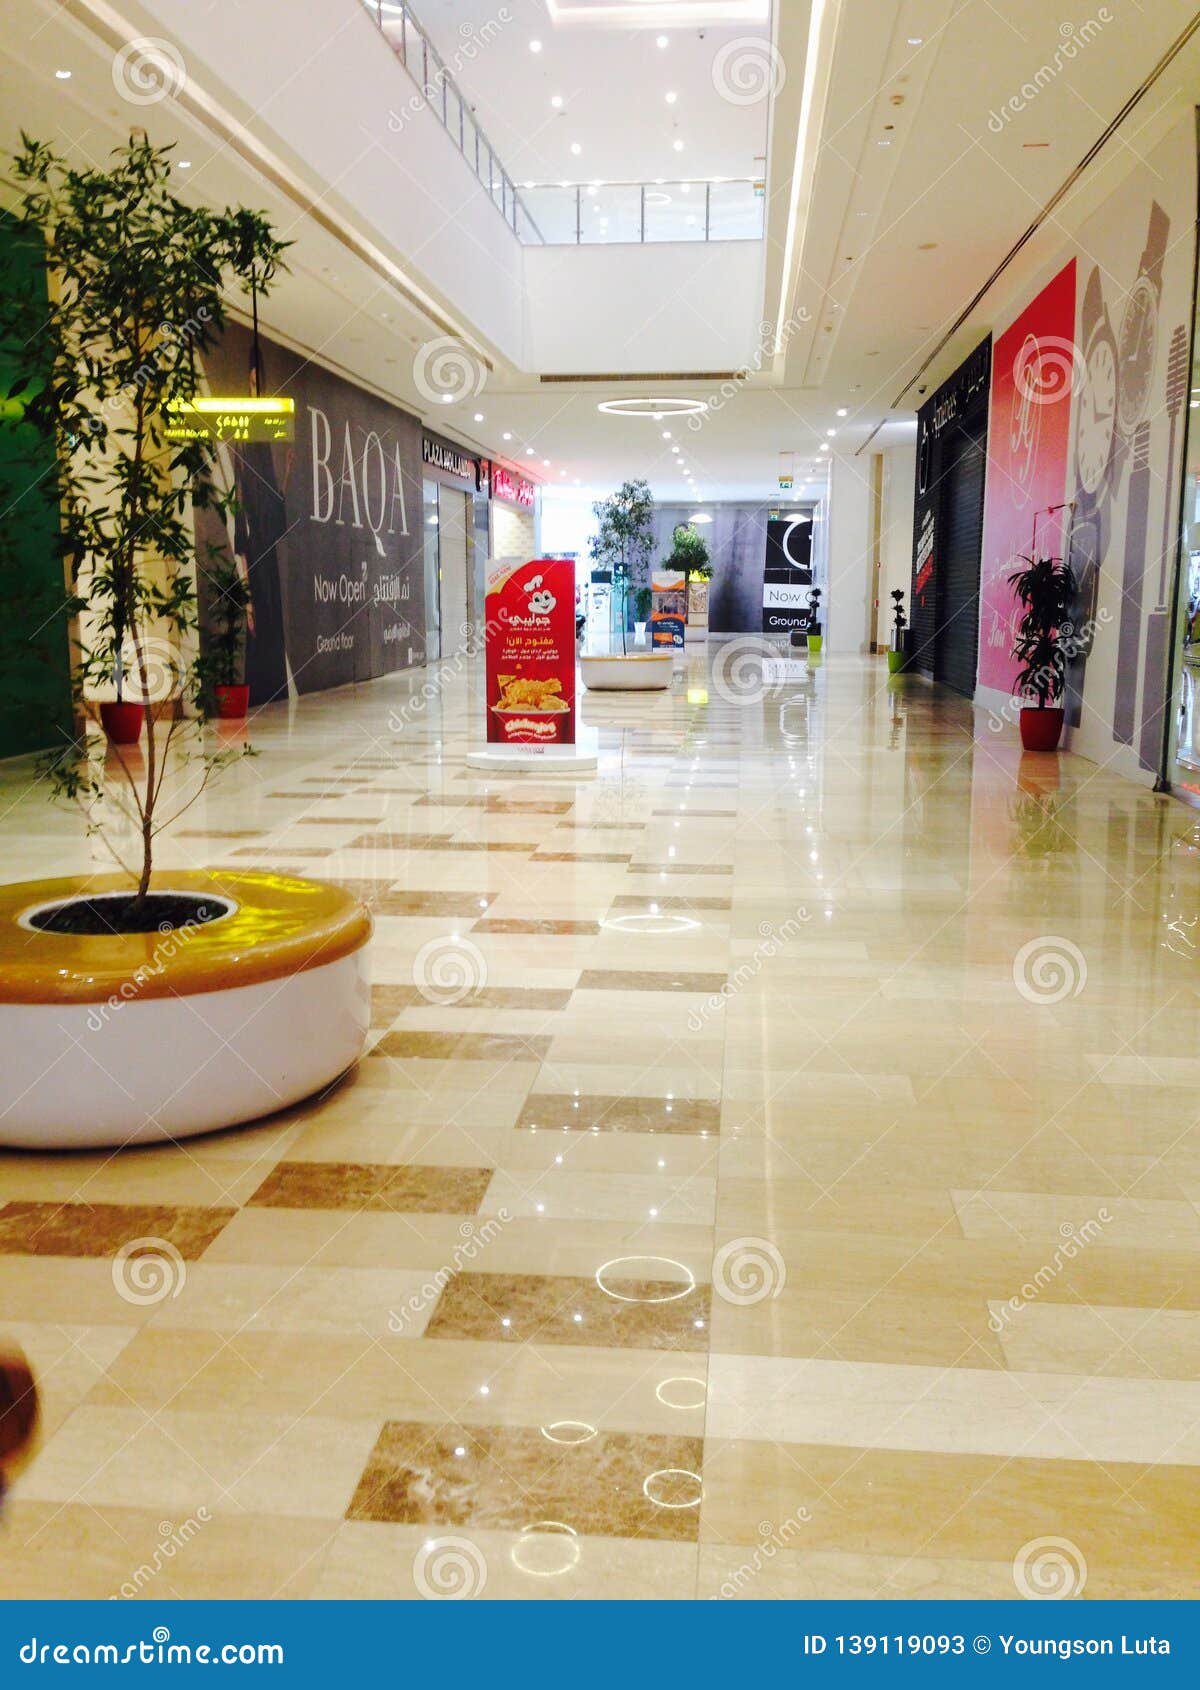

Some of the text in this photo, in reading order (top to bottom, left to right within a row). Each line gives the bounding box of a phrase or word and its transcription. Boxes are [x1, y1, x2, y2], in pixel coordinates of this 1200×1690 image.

[307, 406, 410, 557] BAQA
[314, 574, 366, 608] Now Open
[769, 590, 800, 602] Now
[509, 613, 551, 627] جوليبي
[769, 615, 807, 627] Ground
